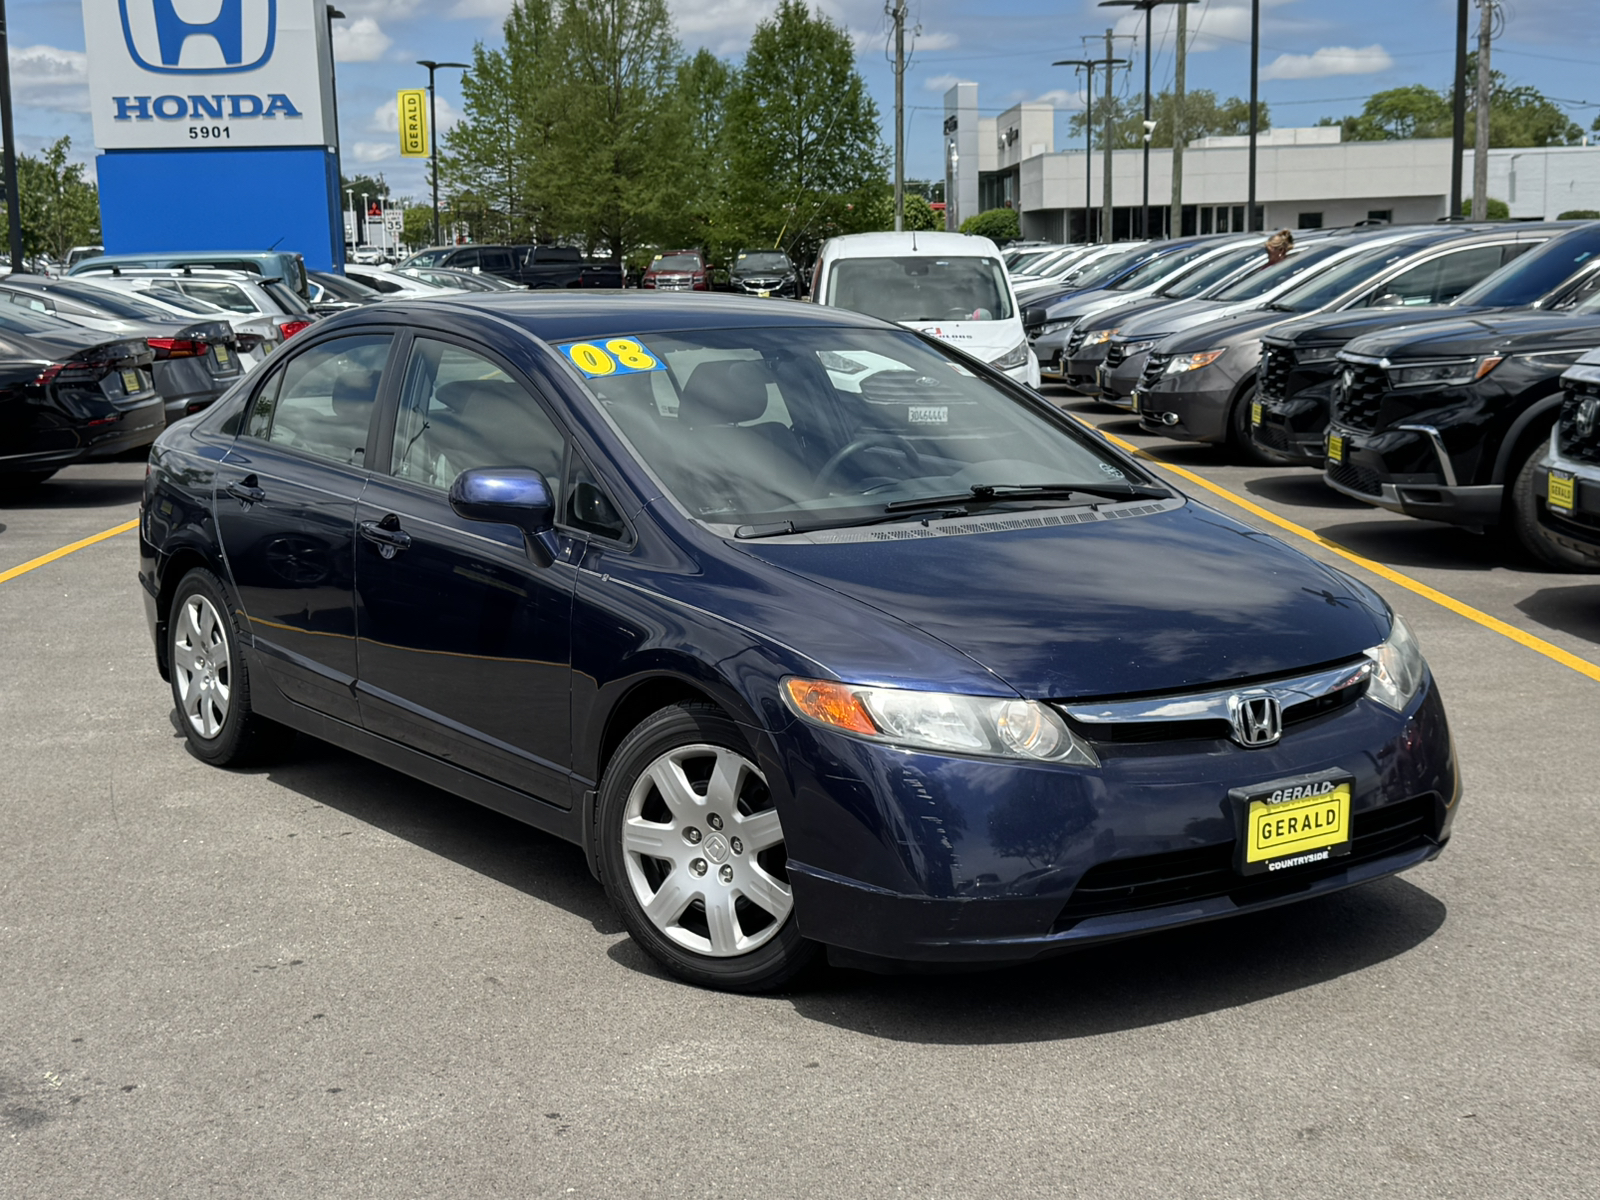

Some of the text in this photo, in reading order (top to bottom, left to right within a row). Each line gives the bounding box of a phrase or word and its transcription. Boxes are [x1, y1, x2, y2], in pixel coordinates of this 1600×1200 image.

[112, 94, 303, 120] HONDA
[189, 126, 230, 139] 5901
[407, 97, 419, 149] GERALD
[387, 221, 402, 230] 35
[569, 338, 657, 376] 08
[1551, 485, 1571, 499] GERALD
[1271, 781, 1331, 804] GERALD
[1262, 809, 1336, 840] GERALD
[1268, 851, 1329, 871] COUNTRYSIDE
